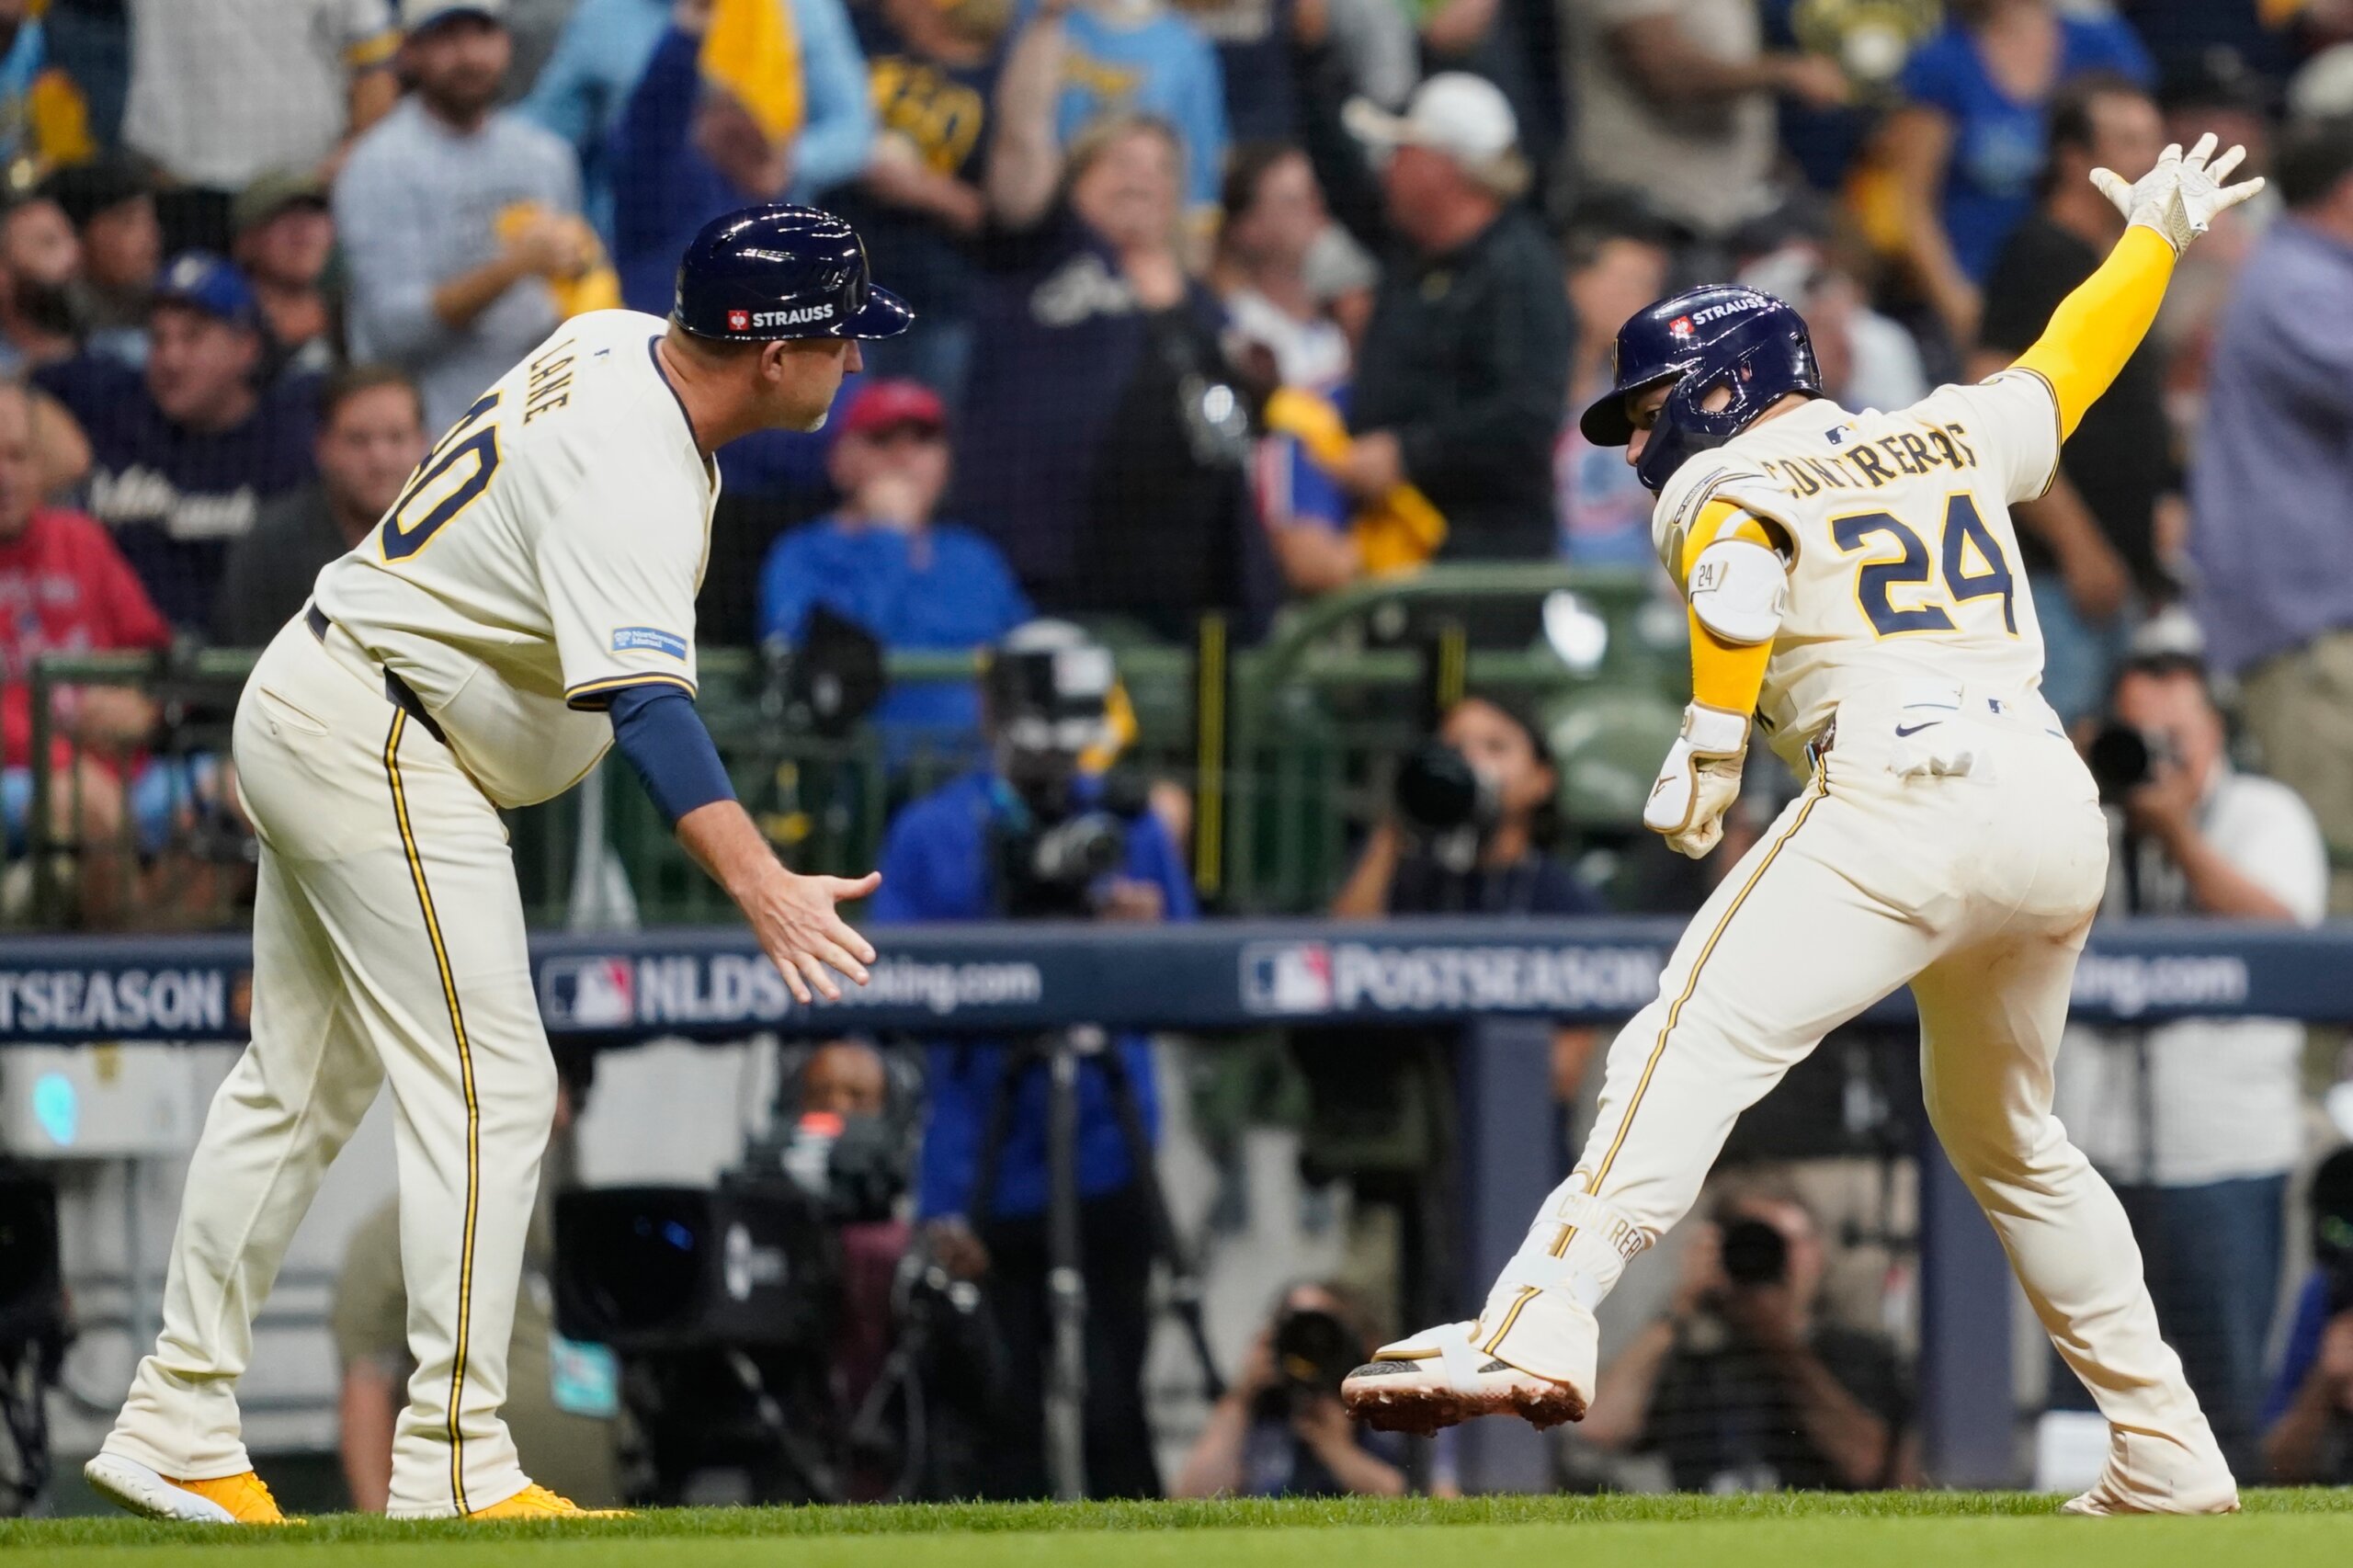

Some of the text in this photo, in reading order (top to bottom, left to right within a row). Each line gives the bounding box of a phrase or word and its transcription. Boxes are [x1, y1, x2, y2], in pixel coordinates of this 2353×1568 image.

[752, 303, 835, 327] STRAUSS
[1692, 296, 1768, 325] STRAUSS
[522, 337, 576, 426] LANE
[378, 389, 504, 565] 0
[1698, 563, 1713, 586] 24
[1827, 489, 2021, 640] 24
[641, 956, 789, 1023] NLDS
[1336, 943, 1660, 1011] POSTSEASON
